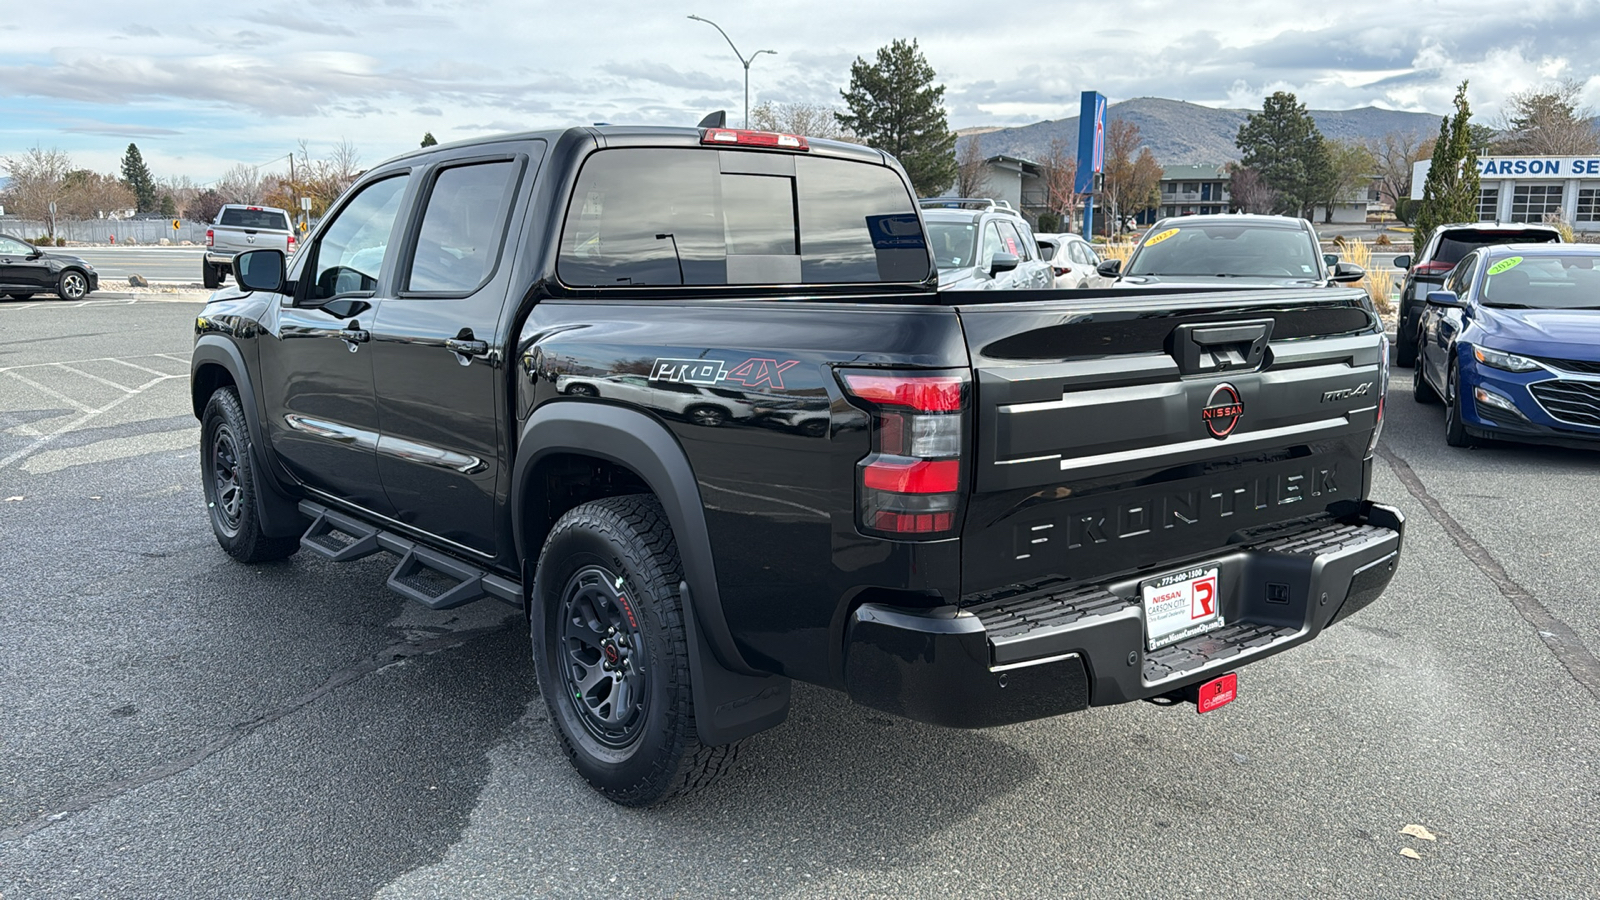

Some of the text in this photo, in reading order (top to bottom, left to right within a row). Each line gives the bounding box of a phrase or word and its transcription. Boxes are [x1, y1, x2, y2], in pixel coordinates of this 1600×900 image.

[1203, 404, 1243, 419] NISSAN
[1013, 466, 1338, 560] FRONTIER
[1161, 568, 1203, 586] 775-600-1500
[1147, 597, 1187, 615] CARSON CITY
[1152, 590, 1182, 604] NISSAN
